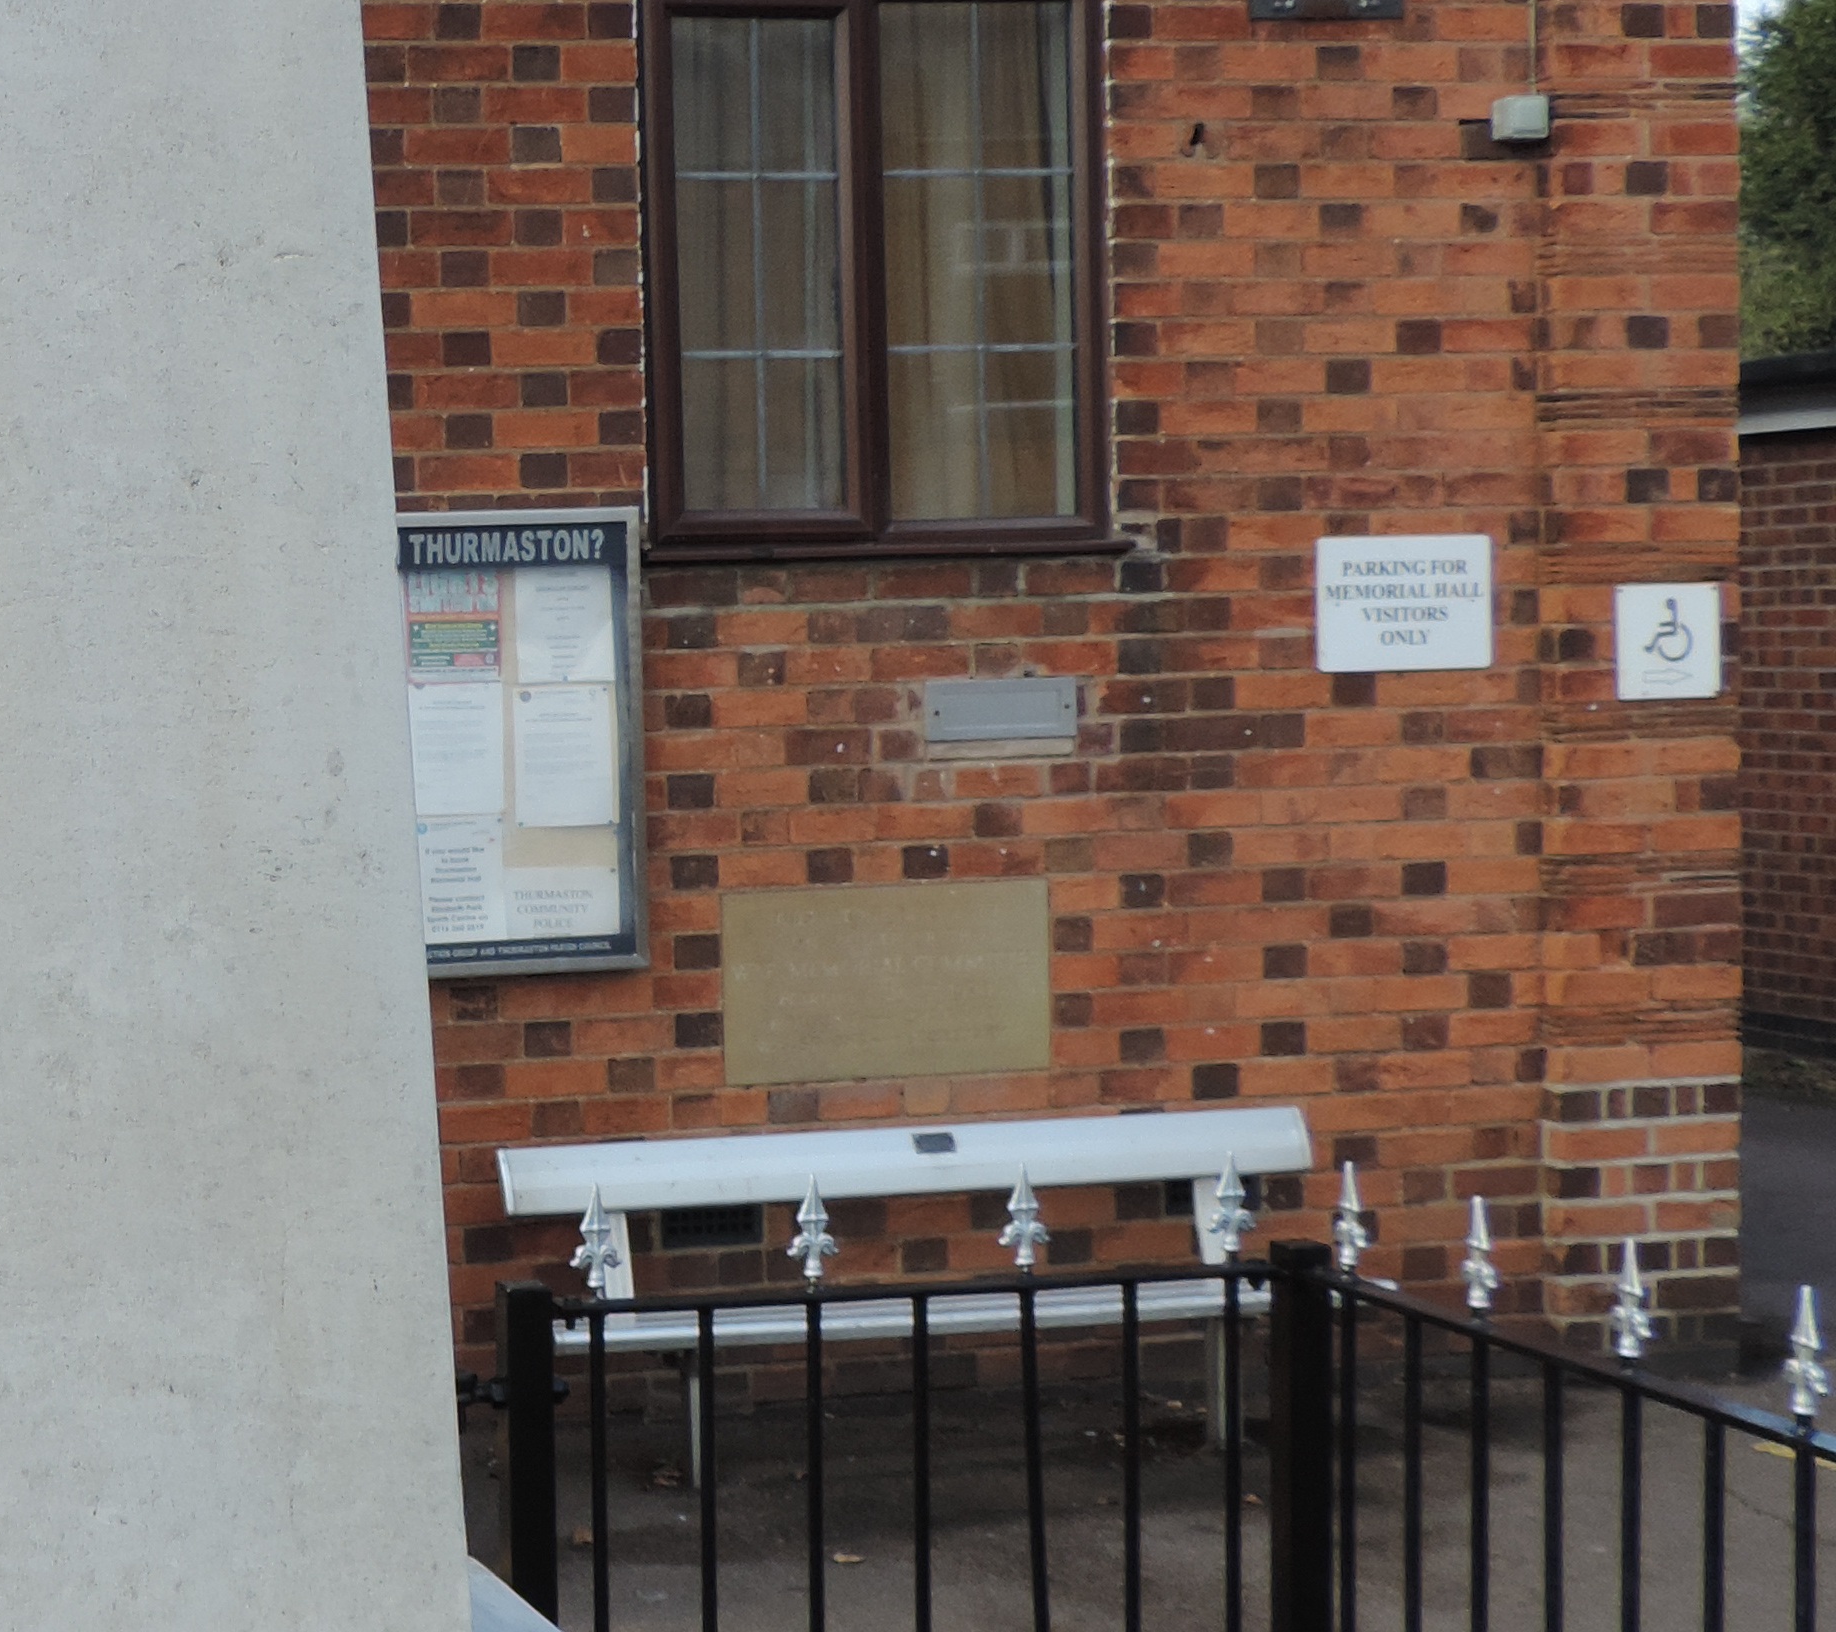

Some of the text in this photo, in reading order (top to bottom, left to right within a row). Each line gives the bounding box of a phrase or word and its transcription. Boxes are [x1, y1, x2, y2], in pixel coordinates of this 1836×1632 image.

[408, 528, 605, 565] THURMASTON?
[1341, 558, 1468, 577] PARKING FOR
[1324, 581, 1485, 600] MEMORIAL HALL
[1362, 606, 1450, 623] VISITORS
[1379, 629, 1431, 646] ONLY
